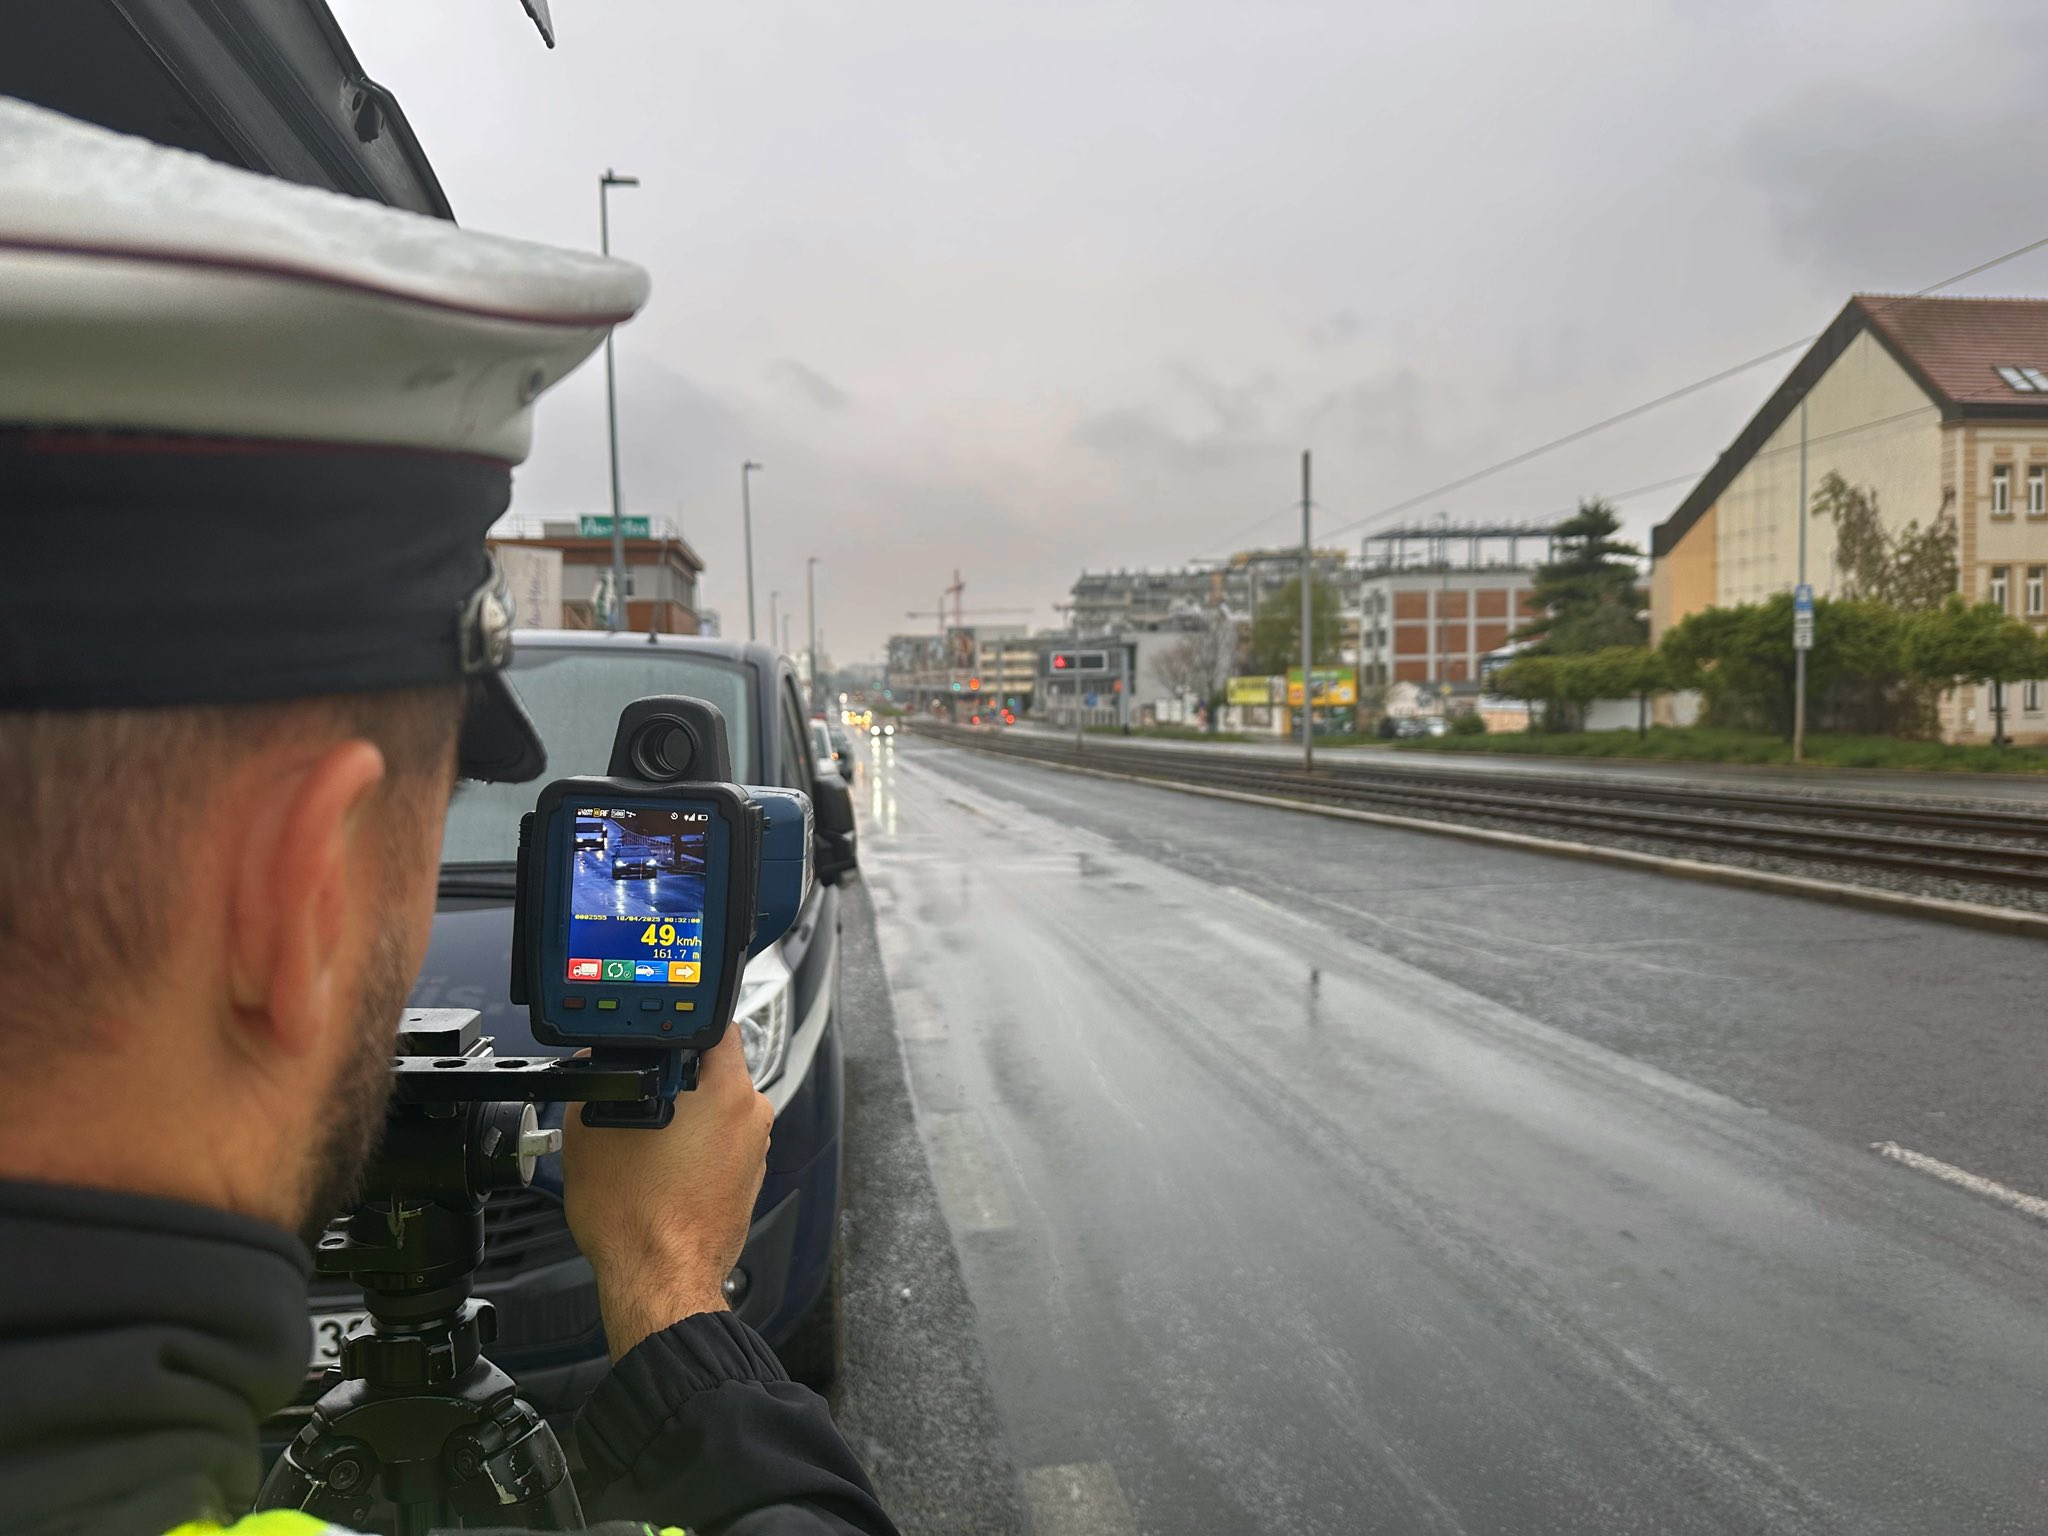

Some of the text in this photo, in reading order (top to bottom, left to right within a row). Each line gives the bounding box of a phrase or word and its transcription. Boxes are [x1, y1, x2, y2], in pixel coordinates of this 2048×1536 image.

[641, 924, 702, 946] 49 km/h
[653, 949, 687, 959] 161.7
